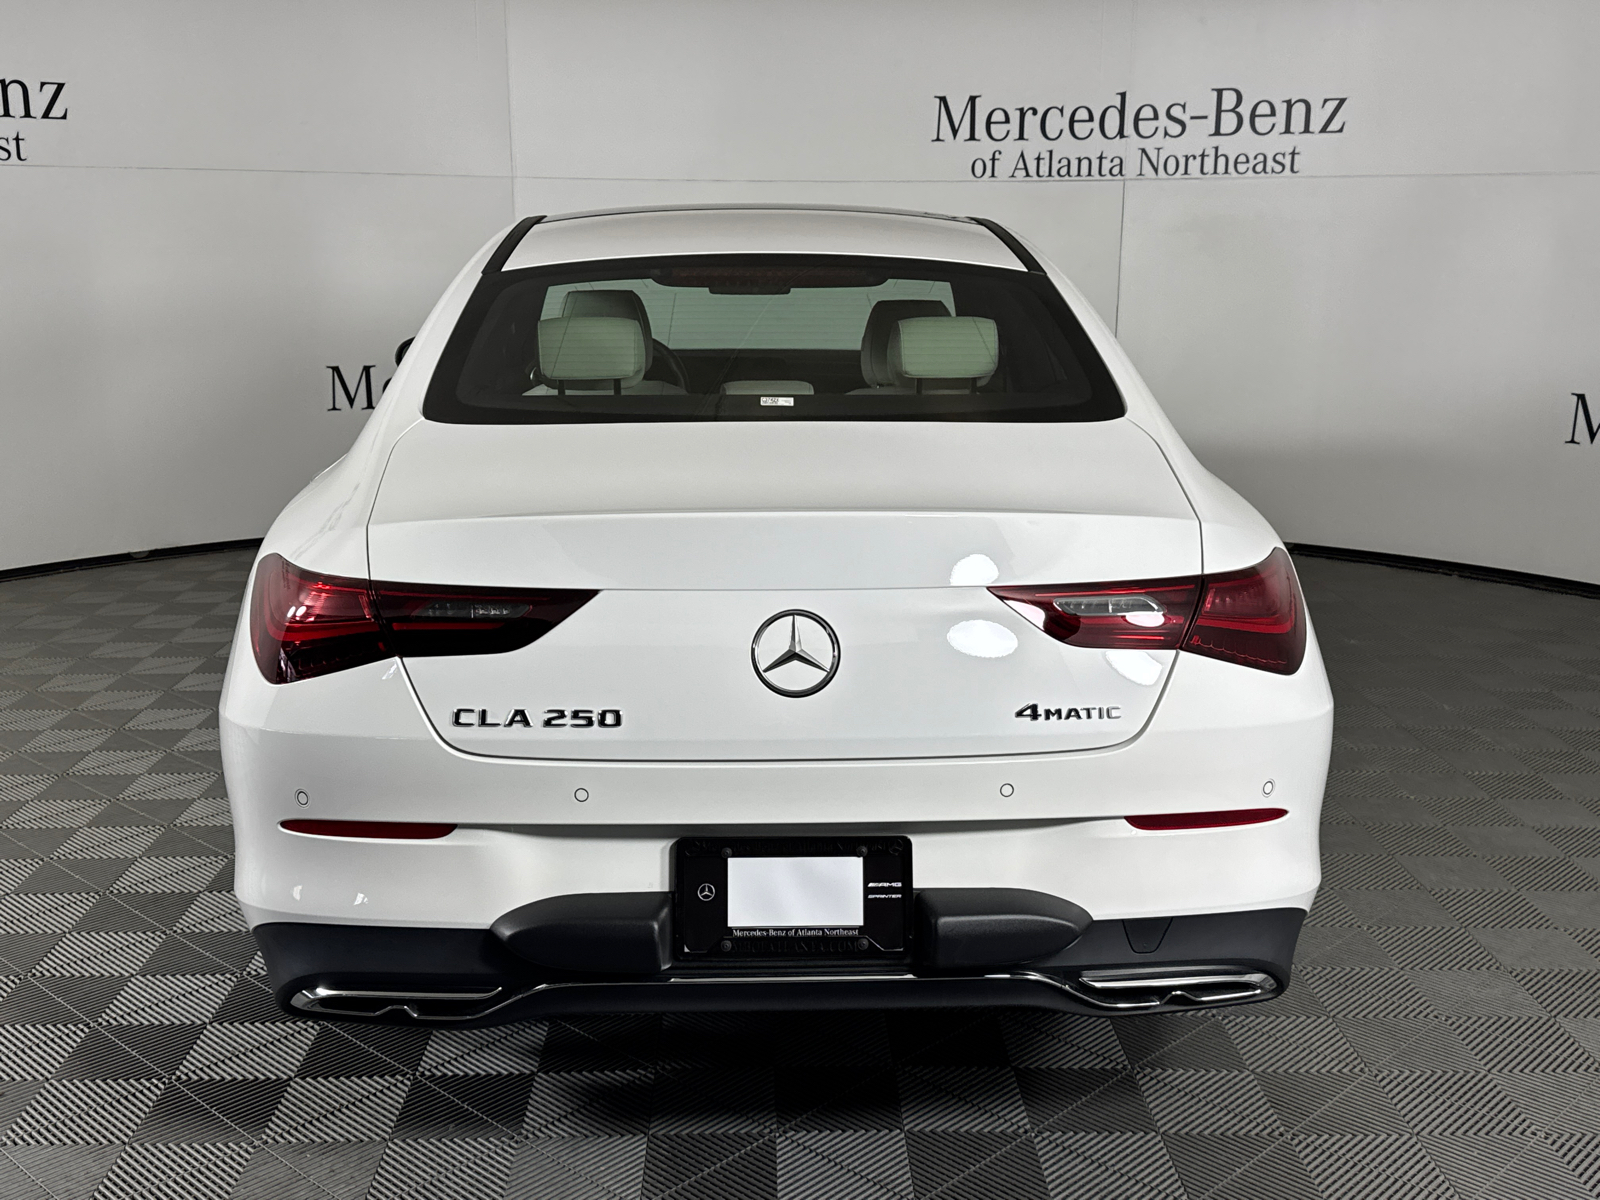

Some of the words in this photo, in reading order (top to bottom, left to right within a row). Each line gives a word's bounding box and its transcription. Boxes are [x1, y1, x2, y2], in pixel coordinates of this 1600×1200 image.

[931, 87, 1348, 143] Mercedes-Benz
[970, 150, 1002, 179] of
[1008, 149, 1126, 178] Atlanta
[1136, 145, 1301, 177] Northeast
[452, 708, 533, 728] CLA
[542, 708, 623, 728] 250
[1014, 702, 1122, 721] 4MATIC
[732, 928, 786, 938] Mercedes-Benz
[787, 928, 795, 937] of
[796, 928, 823, 937] Atlanta
[824, 927, 859, 937] Northeast
